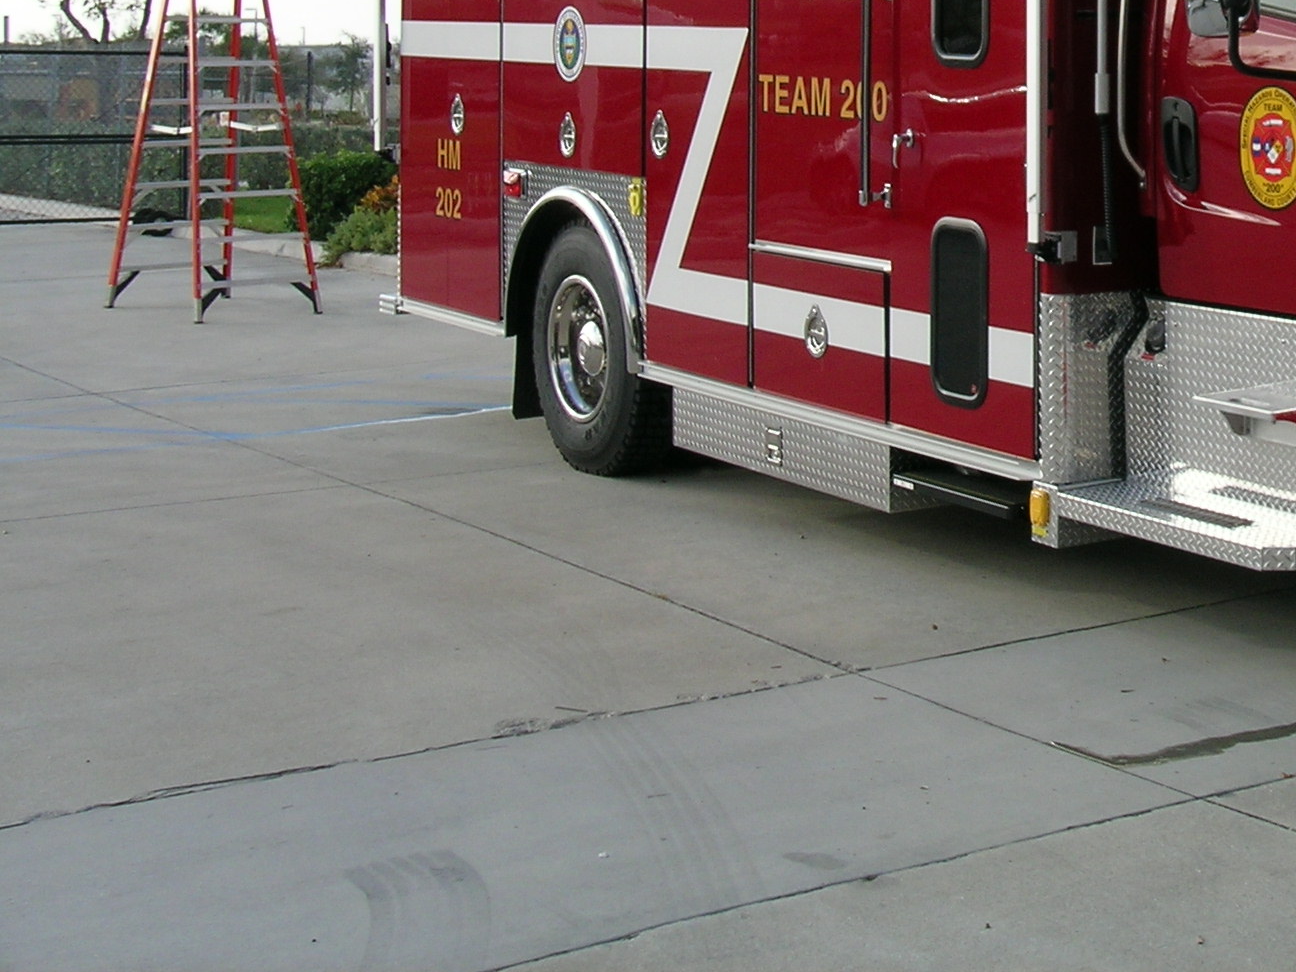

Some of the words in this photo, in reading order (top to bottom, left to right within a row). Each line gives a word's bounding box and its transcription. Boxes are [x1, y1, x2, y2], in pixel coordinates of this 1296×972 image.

[758, 73, 831, 117] TEAM
[1263, 102, 1283, 112] TEAM
[437, 138, 461, 170] HM
[435, 186, 462, 219] 202
